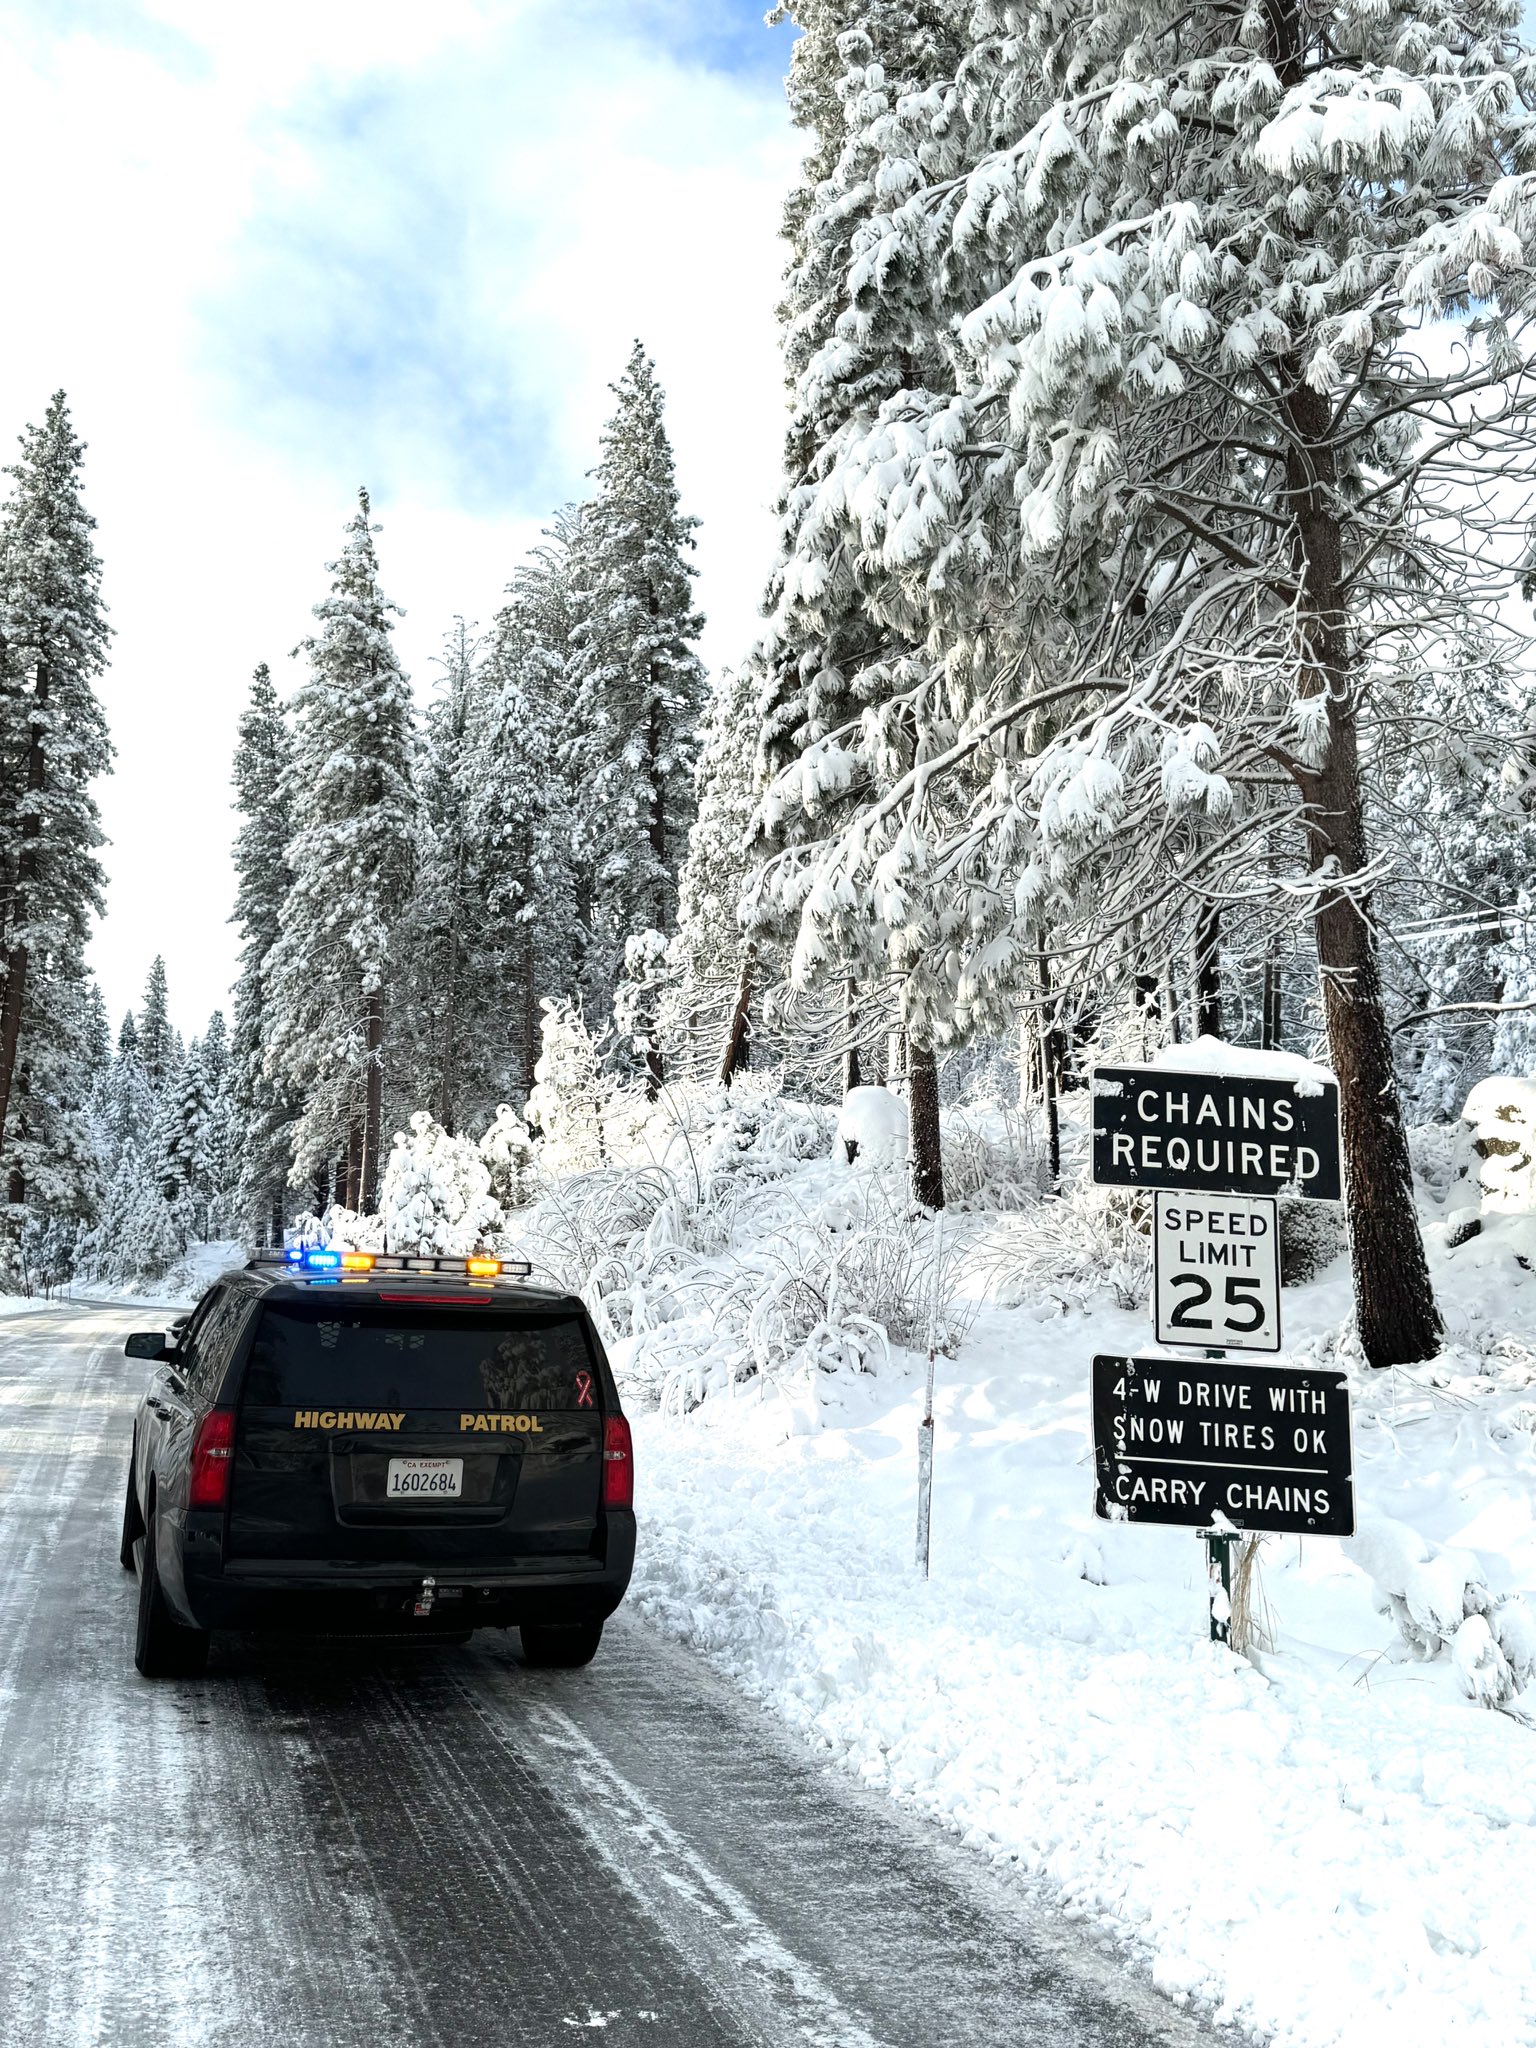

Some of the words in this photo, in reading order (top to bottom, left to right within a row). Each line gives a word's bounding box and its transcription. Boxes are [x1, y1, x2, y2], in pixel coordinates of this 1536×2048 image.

[1137, 1089, 1294, 1132] CHAINS
[1112, 1133, 1320, 1179] REQUIRED
[1164, 1208, 1268, 1236] SPEED
[1179, 1240, 1256, 1267] LIMIT
[1169, 1273, 1266, 1332] 25
[1112, 1377, 1161, 1403] 4-W
[1178, 1381, 1252, 1410] DRIVE
[1268, 1387, 1326, 1415] WITH
[294, 1411, 406, 1431] HIGHWAY
[459, 1414, 544, 1432] PATROL
[1113, 1415, 1184, 1444] SNOW
[1199, 1422, 1275, 1451] TIRES
[1293, 1428, 1327, 1454] OK
[392, 1473, 456, 1491] 1602684
[1115, 1475, 1207, 1505] CARRY
[1226, 1483, 1330, 1514] CHAINS
